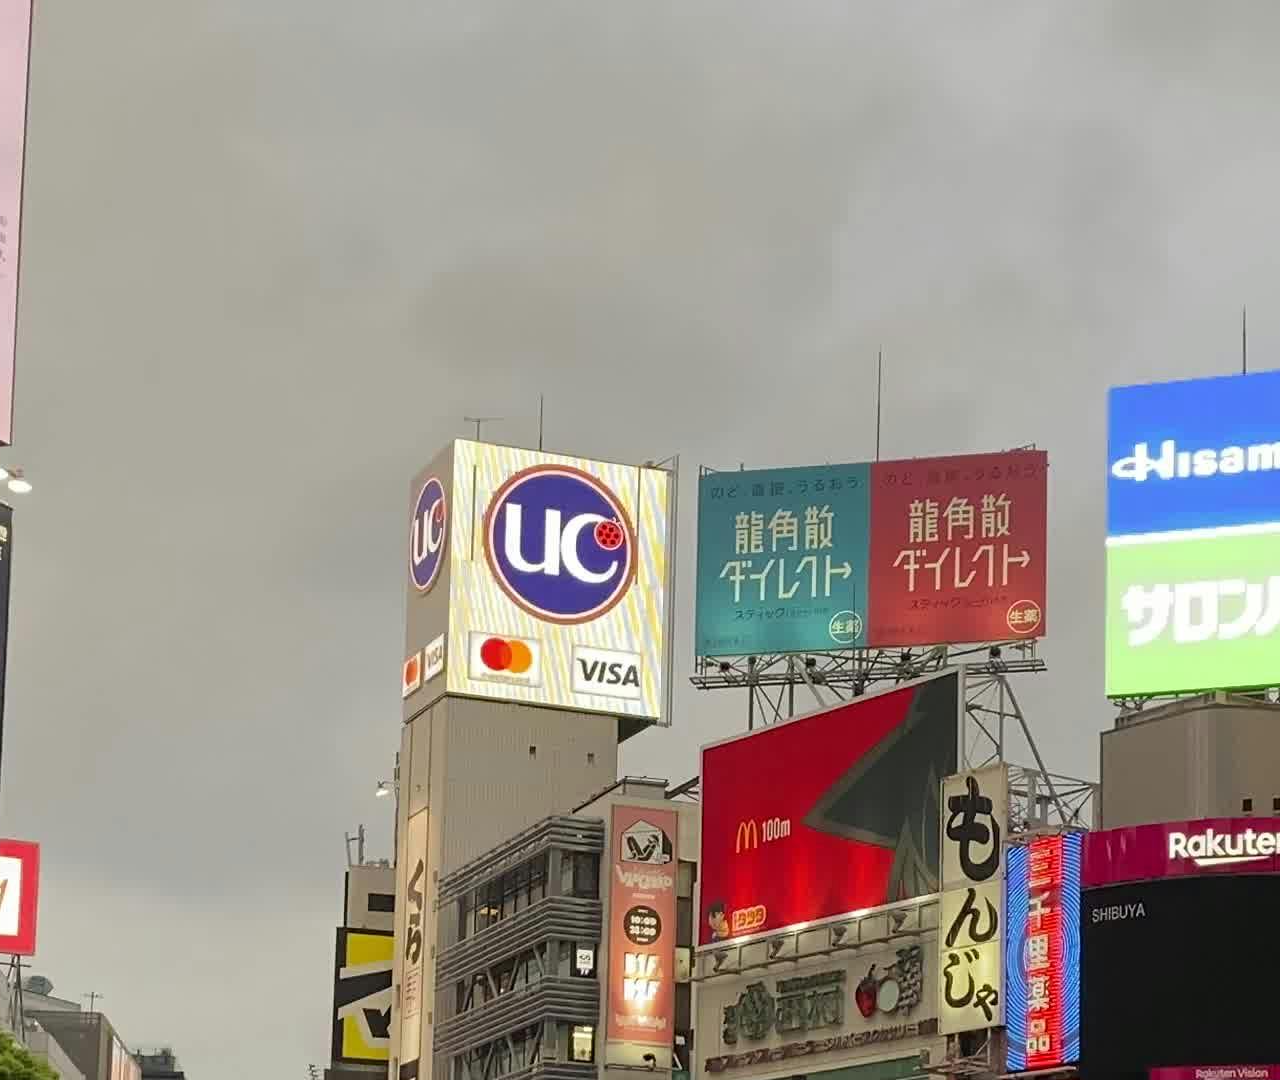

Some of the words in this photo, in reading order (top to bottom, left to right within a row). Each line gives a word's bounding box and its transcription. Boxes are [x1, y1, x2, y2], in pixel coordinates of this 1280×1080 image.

[734, 504, 835, 554] 龍角散
[909, 493, 1012, 544] 龍角散
[505, 502, 619, 584] UC
[720, 554, 852, 602] ダイレクト
[893, 543, 1031, 592] ダイレクト
[576, 657, 640, 687] VISA
[762, 817, 790, 842] 100m
[943, 775, 1001, 1022] もんじゃ
[1091, 903, 1146, 923] SHIBUYA
[1195, 1067, 1237, 1080] Rakuten
[1238, 1067, 1269, 1080] Vision
